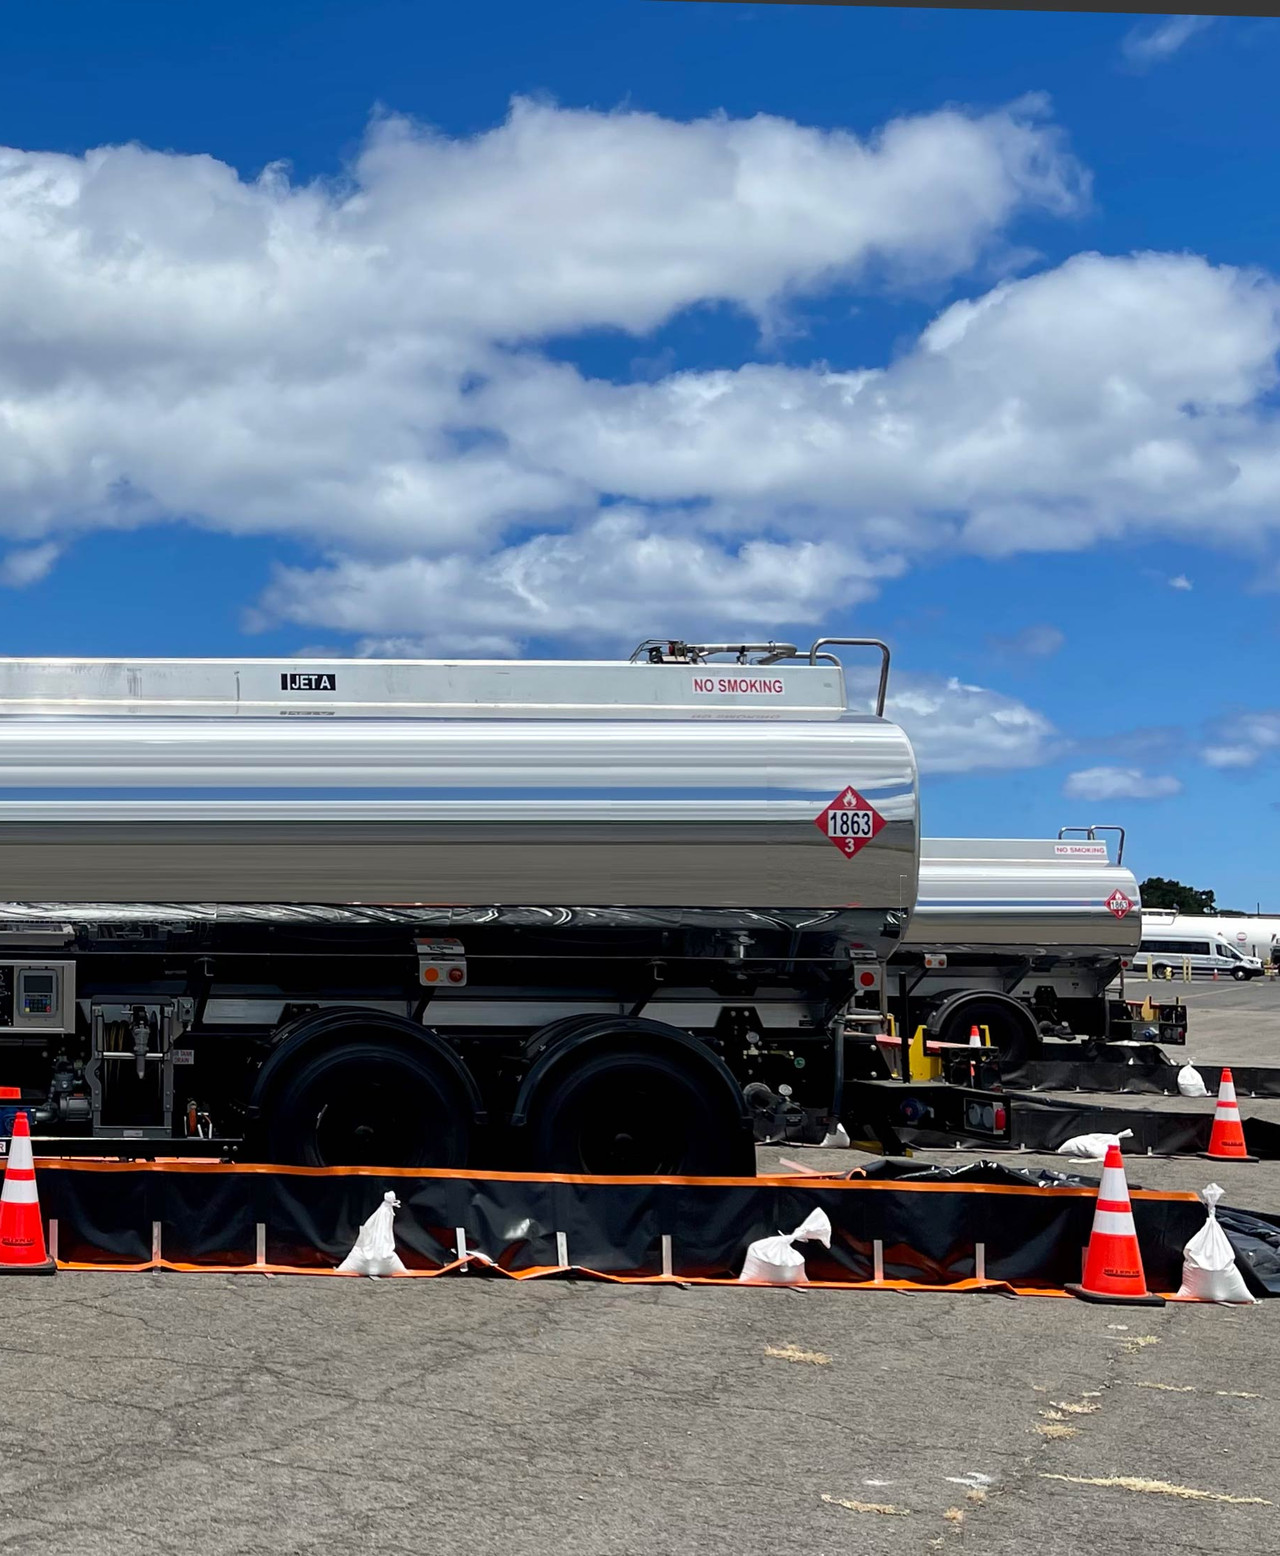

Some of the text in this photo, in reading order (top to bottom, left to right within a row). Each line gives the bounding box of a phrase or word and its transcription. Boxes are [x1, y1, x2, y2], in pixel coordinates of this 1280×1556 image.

[292, 675, 331, 689] JET A
[694, 679, 783, 693] NO SMOKING
[830, 812, 871, 836] 1863
[844, 838, 855, 852] 3
[1111, 901, 1128, 909] 1863
